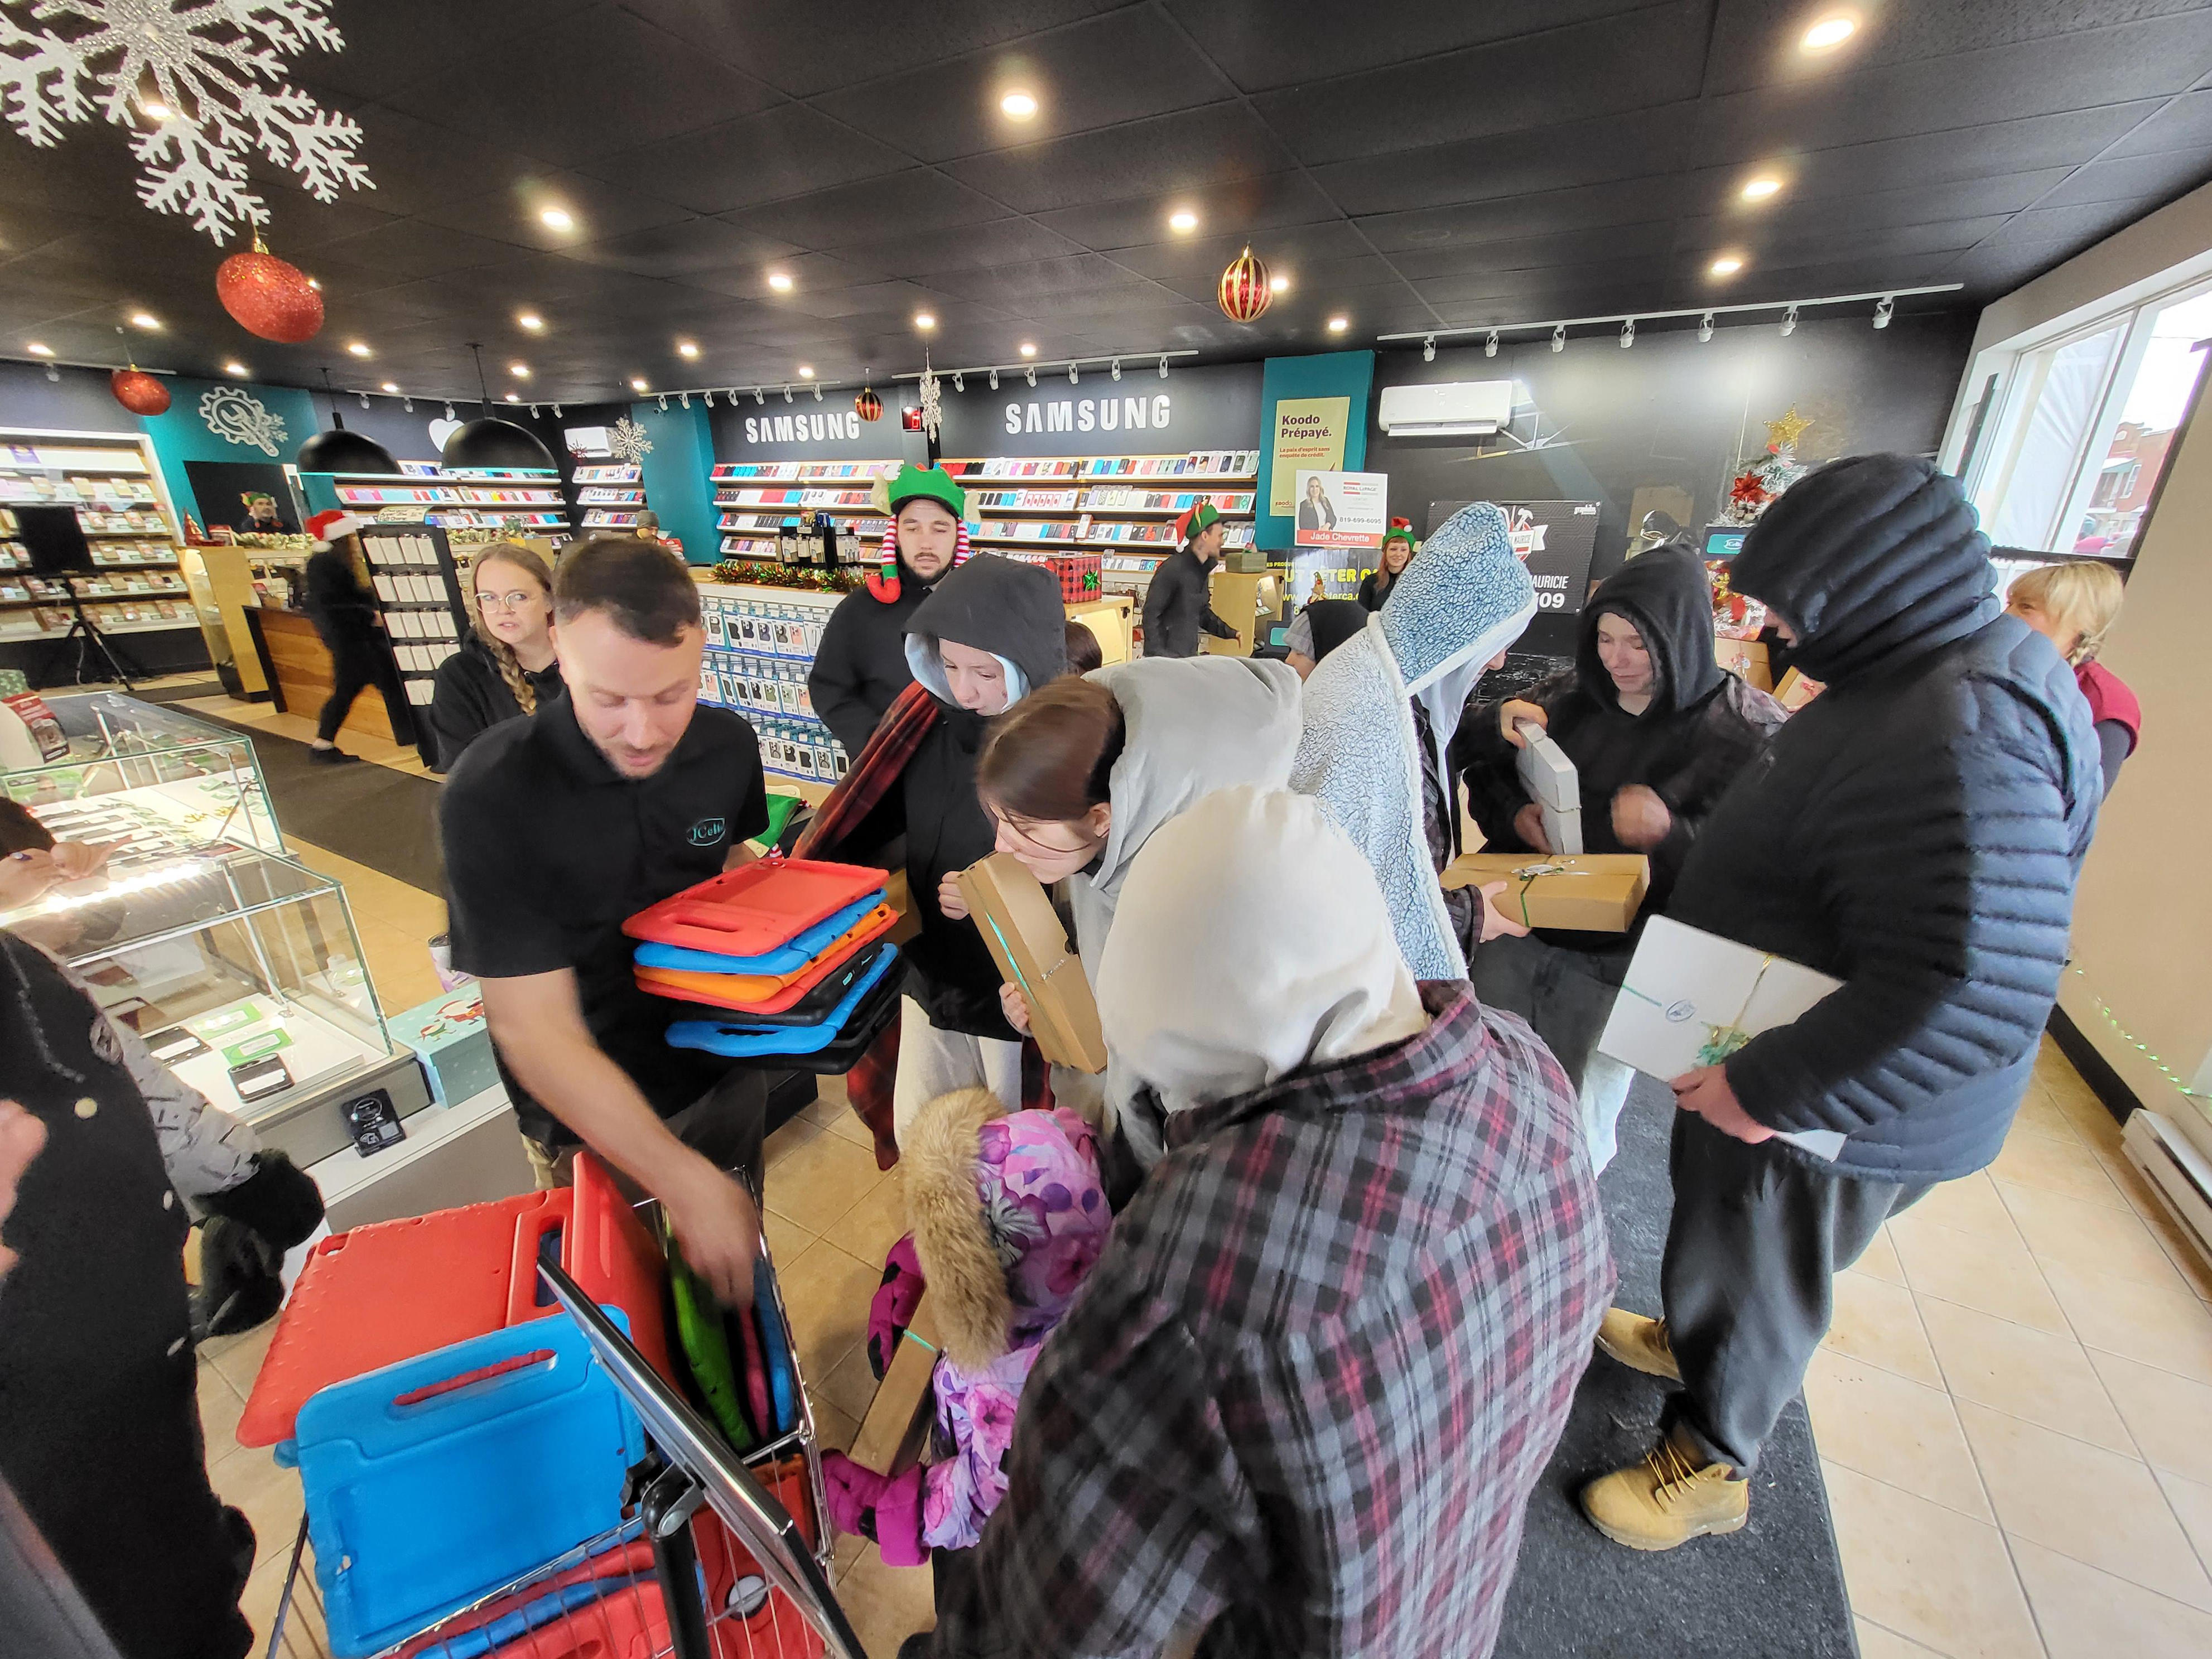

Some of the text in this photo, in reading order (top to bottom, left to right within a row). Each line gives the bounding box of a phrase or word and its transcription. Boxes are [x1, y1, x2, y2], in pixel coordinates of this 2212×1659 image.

[1005, 394, 1170, 435] SAMSUNG
[1282, 414, 1320, 425] Koodo
[745, 411, 860, 443] SAMSUNG
[1281, 426, 1332, 440] Prépayé.
[1310, 532, 1370, 542] Jade Chevrette
[1531, 575, 1569, 590] AURICIE
